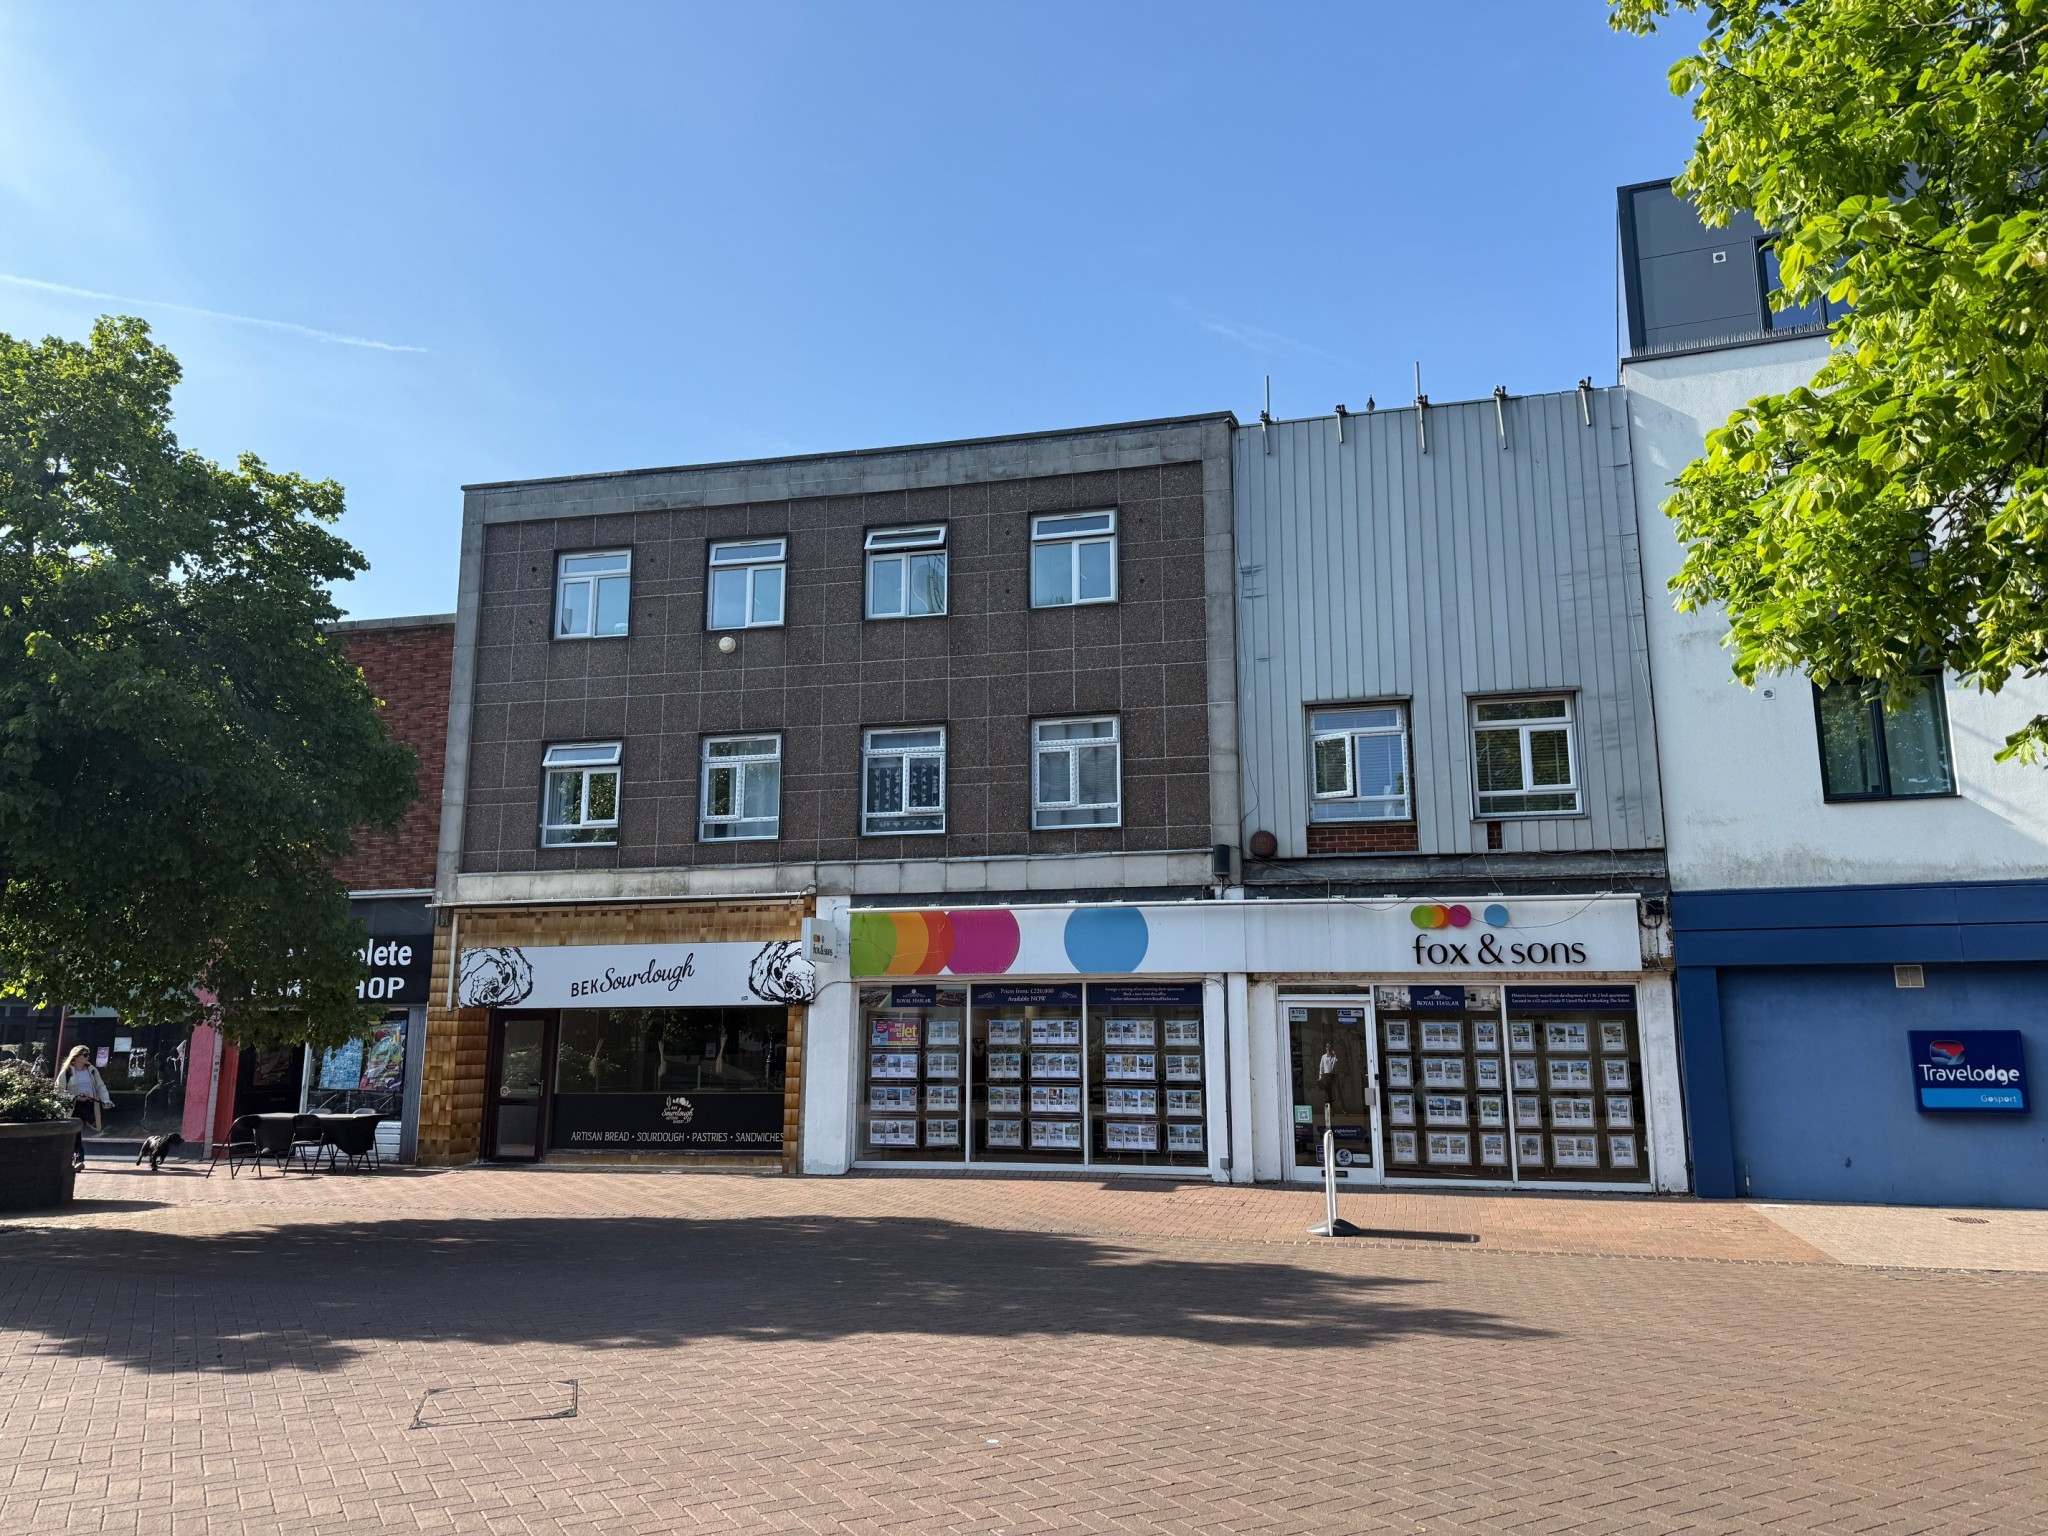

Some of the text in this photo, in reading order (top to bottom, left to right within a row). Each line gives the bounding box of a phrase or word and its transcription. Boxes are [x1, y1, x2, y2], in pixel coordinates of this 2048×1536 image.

[1412, 933, 1587, 965] fox & sons
[570, 952, 696, 998] BEK Sourdough
[901, 1022, 918, 1038] let
[1918, 1064, 2020, 1086] Travelodge
[1980, 1094, 2018, 1105] Gosport
[570, 1131, 785, 1142] ARTISAN BREAD SOURDOUGH PASTRIES SANDWICHES
